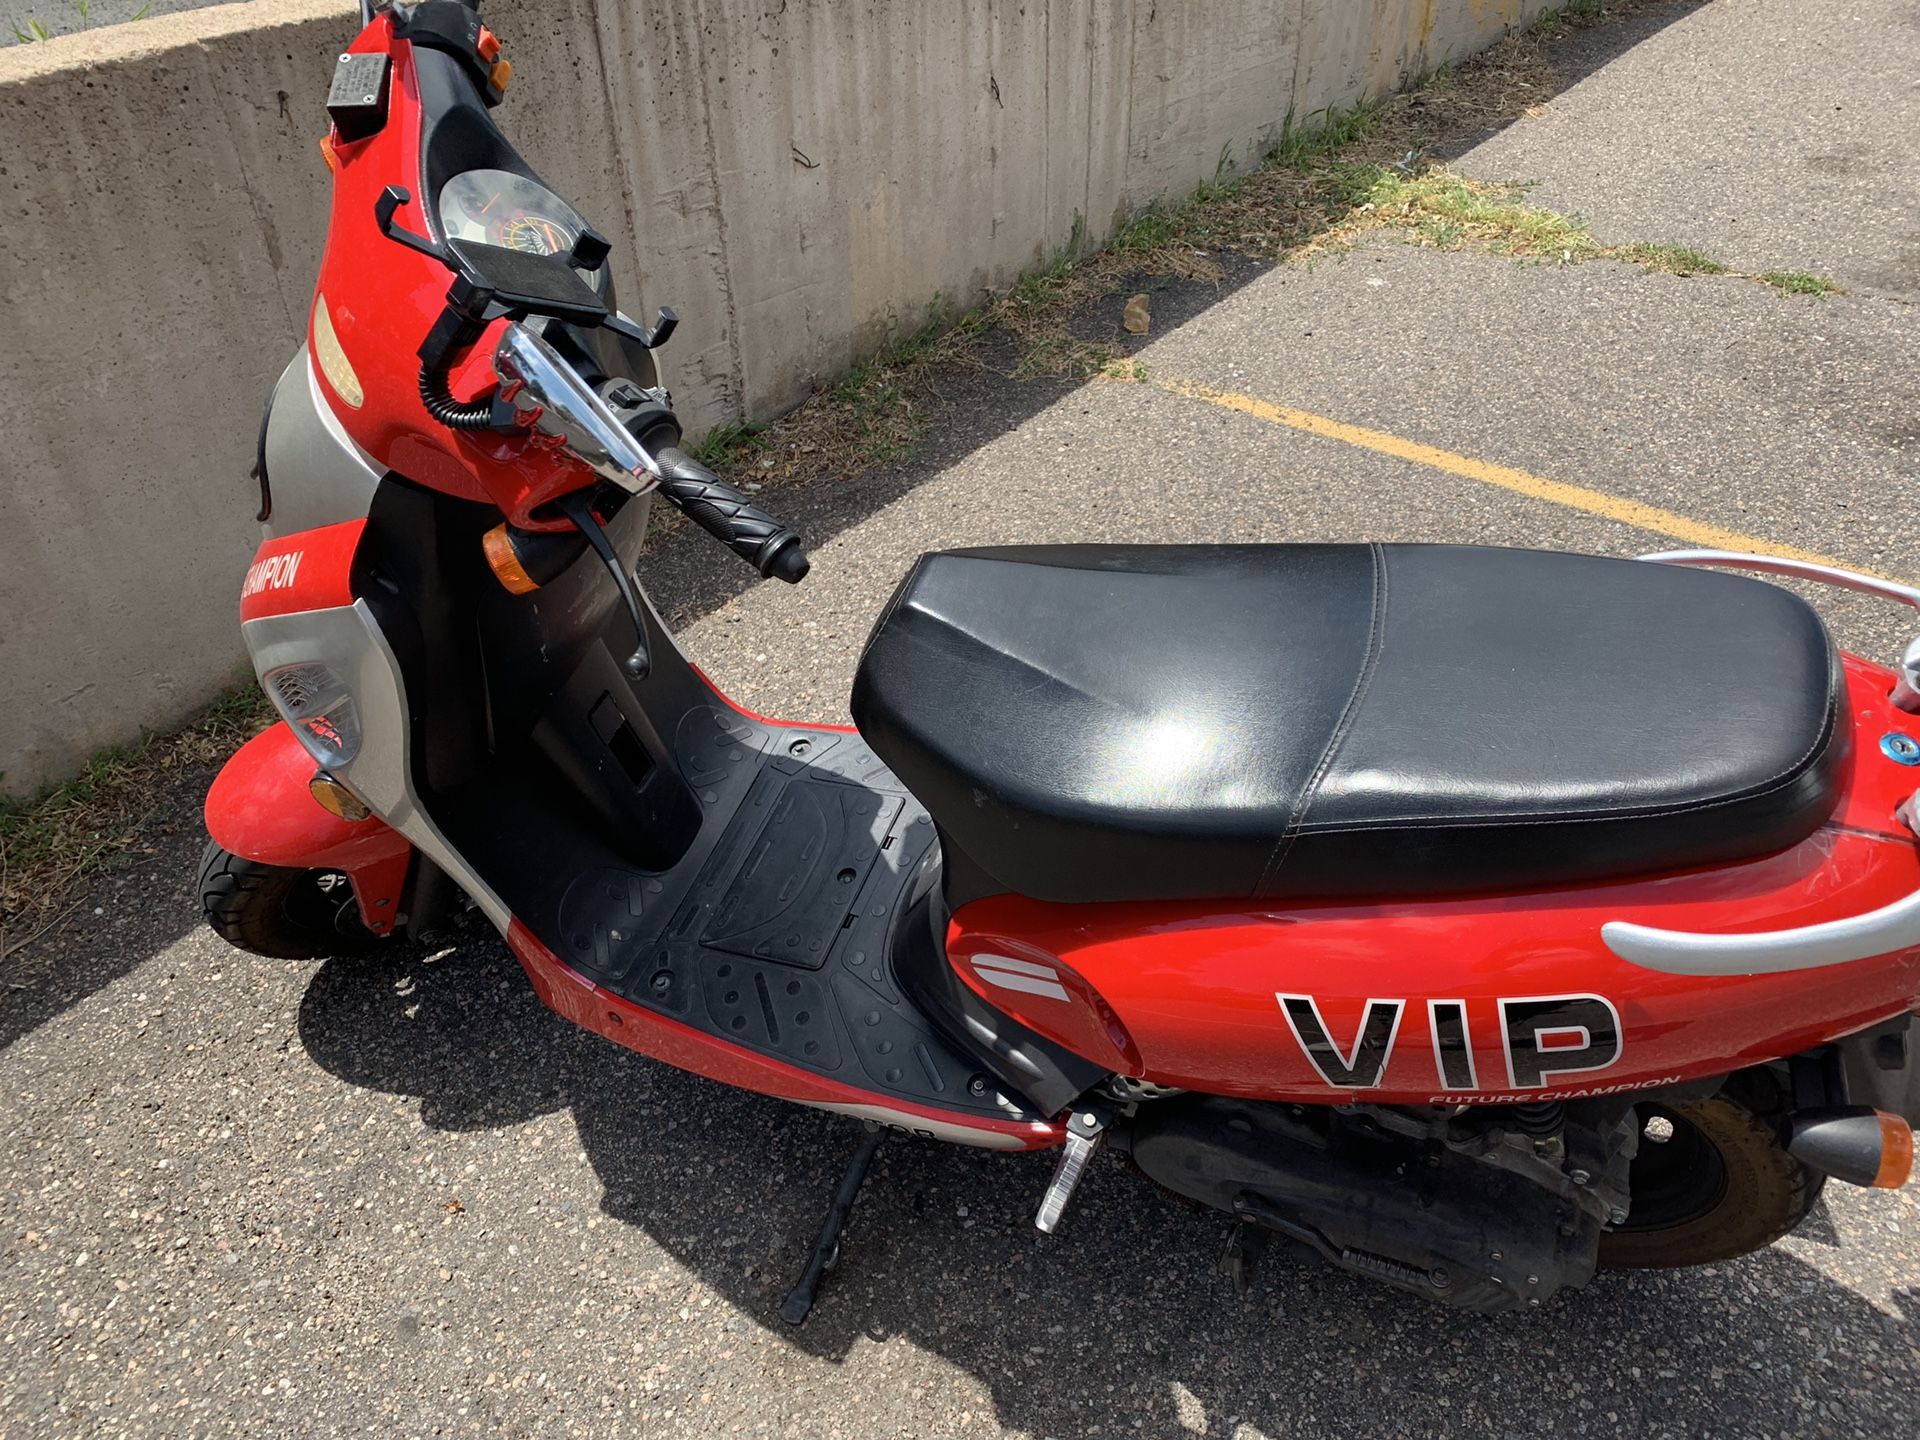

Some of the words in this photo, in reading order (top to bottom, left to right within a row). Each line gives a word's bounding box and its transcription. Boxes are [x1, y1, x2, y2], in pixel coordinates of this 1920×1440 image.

[1274, 992, 1624, 1090] VIP
[1428, 1093, 1532, 1104] FUTURE
[1537, 1075, 1682, 1101] CHAMPION
